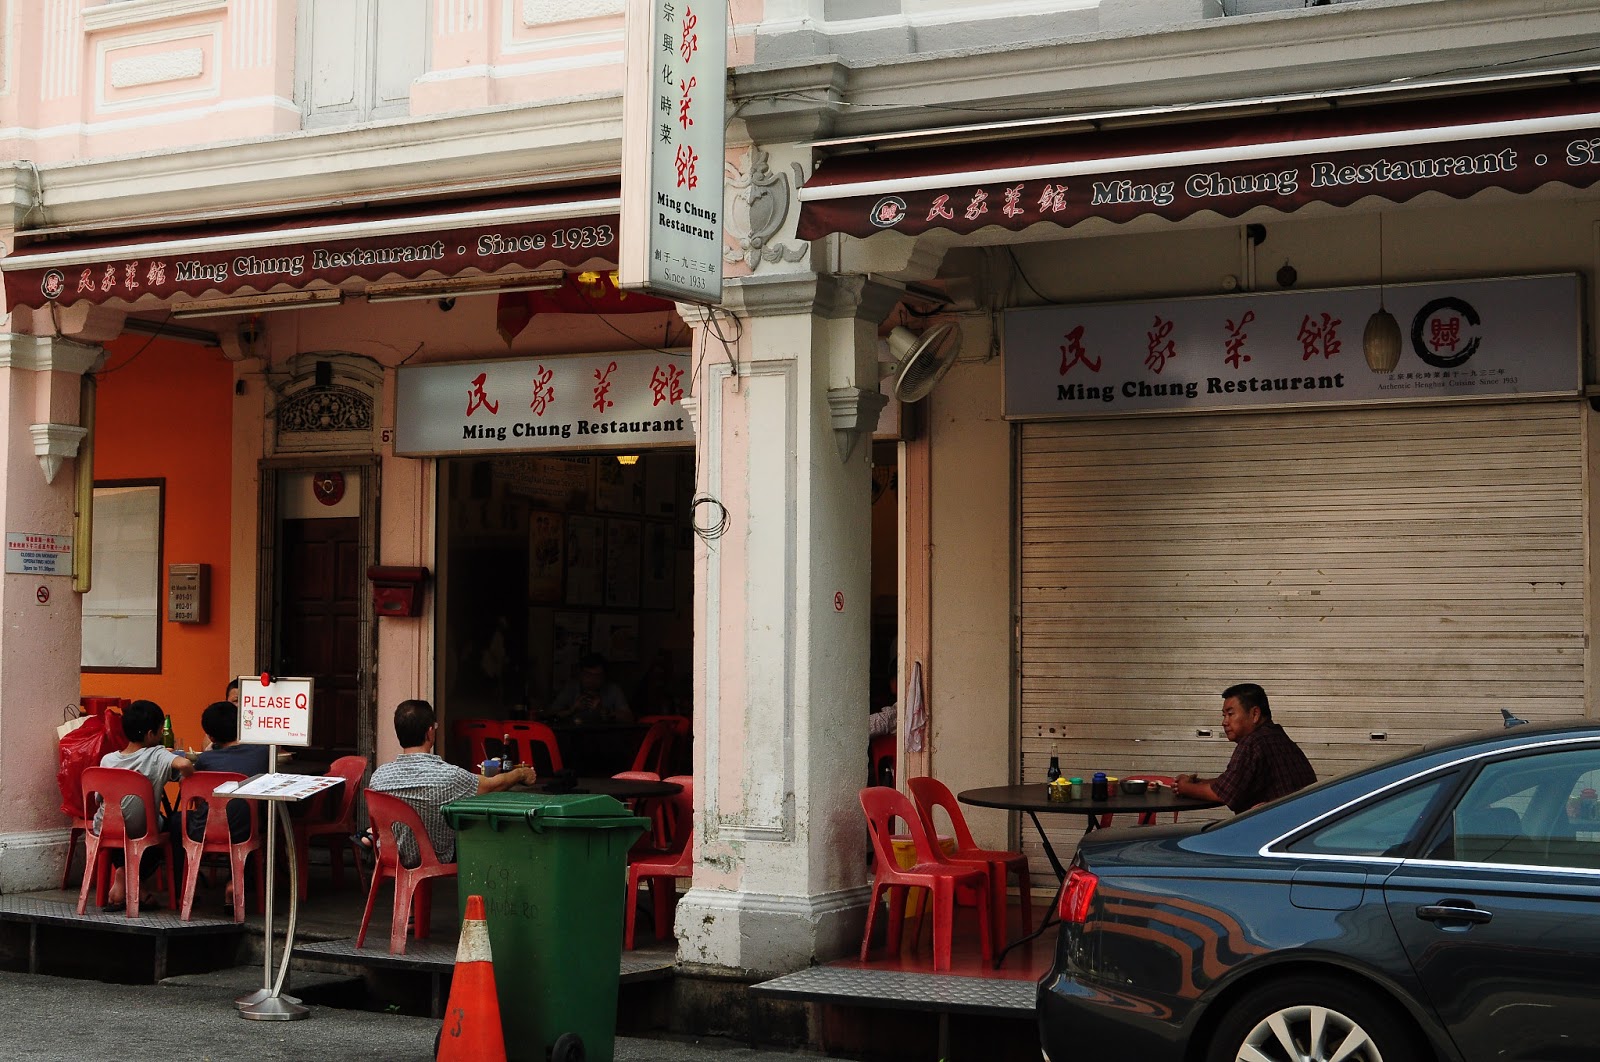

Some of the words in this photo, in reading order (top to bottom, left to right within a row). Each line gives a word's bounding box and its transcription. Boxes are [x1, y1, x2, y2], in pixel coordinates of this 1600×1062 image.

[1091, 180, 1175, 208] Ming
[1185, 167, 1298, 199] Chung
[1310, 148, 1517, 188] Restaurant
[657, 191, 681, 214] Ming
[684, 201, 717, 224] Chung
[659, 212, 714, 241] Restaurant
[176, 261, 228, 282] Ming
[233, 255, 304, 276] Chung
[312, 240, 444, 269] Restaurant
[477, 233, 545, 257] Since
[551, 225, 614, 250] 1933
[664, 267, 686, 286] Since
[689, 273, 706, 290] 1933
[1057, 383, 1115, 402] Ming
[1121, 379, 1198, 400] Chung
[1207, 372, 1344, 394] Restaurant
[1377, 382, 1411, 390] Authentic
[1449, 379, 1476, 387] Cuisine
[1479, 378, 1499, 386] Since
[463, 424, 507, 441] Ming
[513, 422, 571, 440] Chung
[577, 416, 684, 435] Restaurant
[244, 696, 291, 709] PLEASE
[295, 693, 307, 710] Q
[258, 716, 290, 729] HERE
